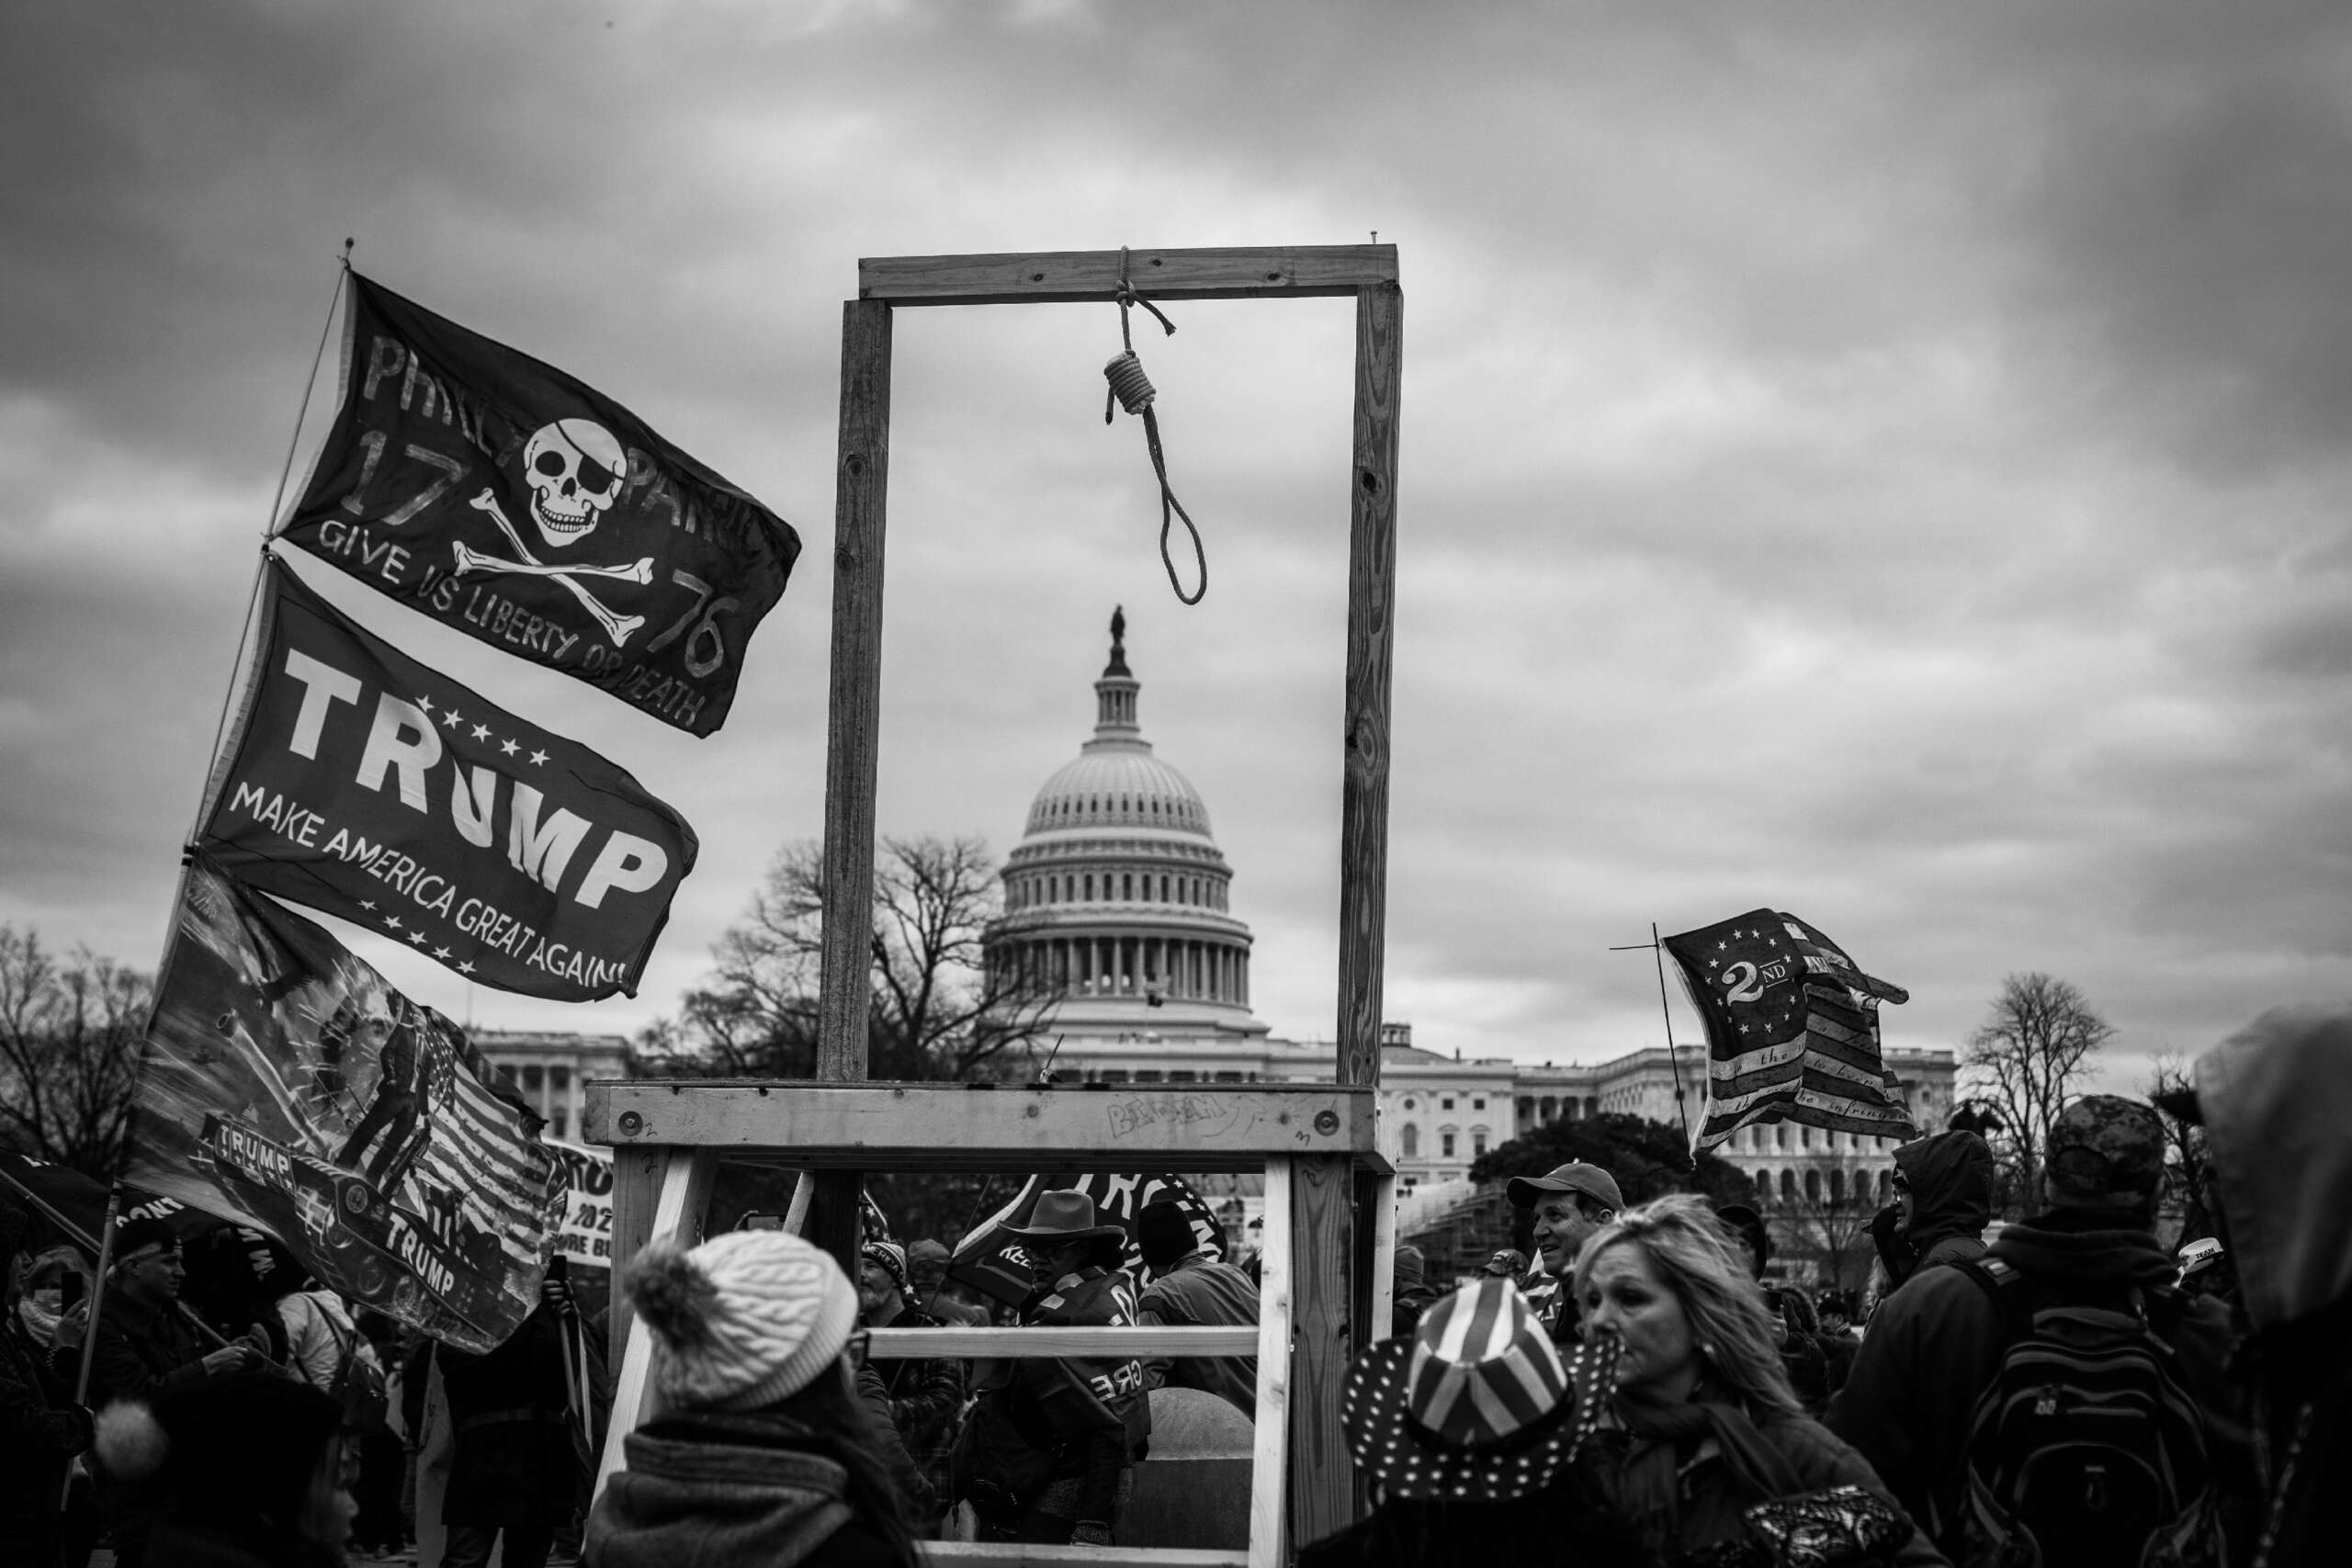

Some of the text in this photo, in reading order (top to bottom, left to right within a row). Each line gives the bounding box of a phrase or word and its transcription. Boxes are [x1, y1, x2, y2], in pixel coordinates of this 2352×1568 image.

[319, 519, 706, 728] GIVE US LIBERTY OR DEATH
[284, 647, 668, 909] TRUMP
[230, 781, 626, 988] MAKE AMERICA GREAT AGAIN!
[220, 1123, 290, 1175] TRUMP
[574, 1202, 612, 1233] 202
[385, 1211, 456, 1298] TRUMP
